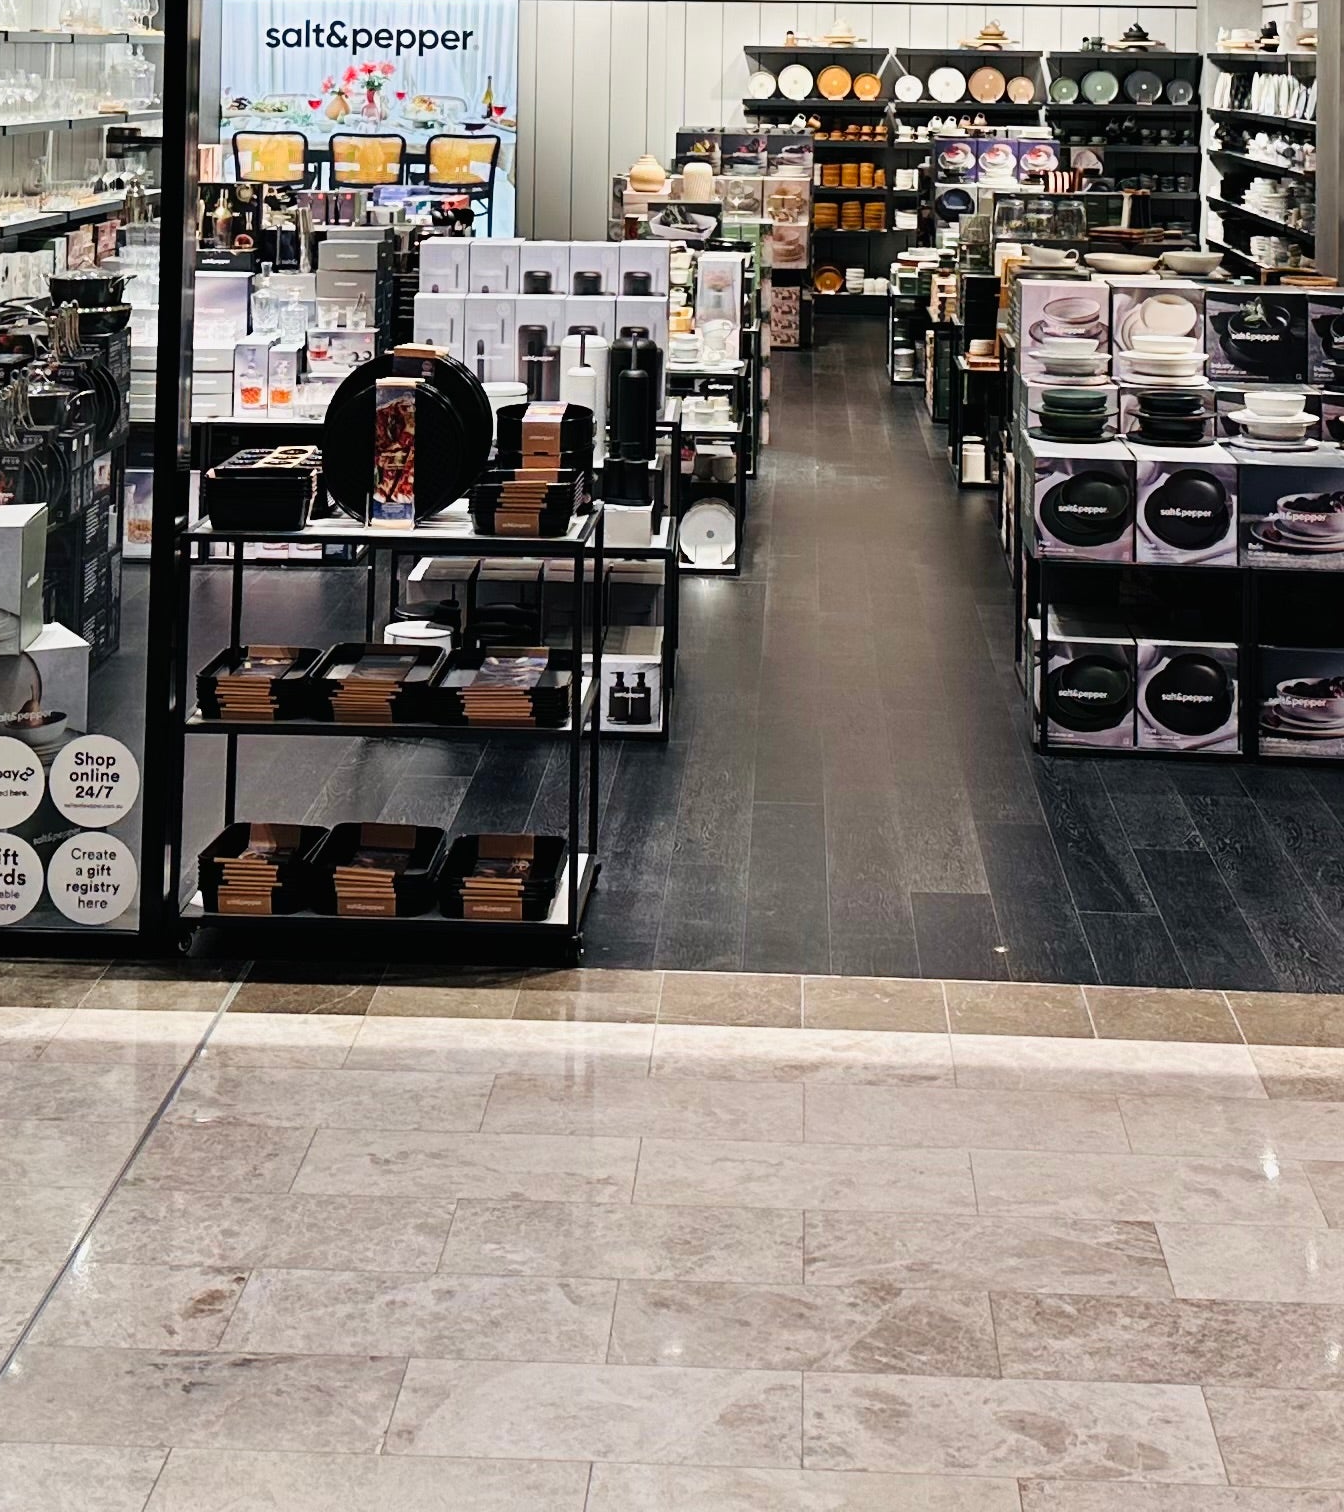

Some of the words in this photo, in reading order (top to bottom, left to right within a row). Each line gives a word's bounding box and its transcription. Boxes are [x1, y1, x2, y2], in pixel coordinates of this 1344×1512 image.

[265, 19, 474, 56] salt&pepper
[74, 752, 116, 769] Shop
[69, 768, 120, 783] online
[75, 785, 114, 799] 24/7
[71, 847, 117, 861] Create
[76, 867, 83, 876] a
[87, 864, 112, 879] gift
[65, 880, 120, 896] registry
[78, 897, 108, 909] here
